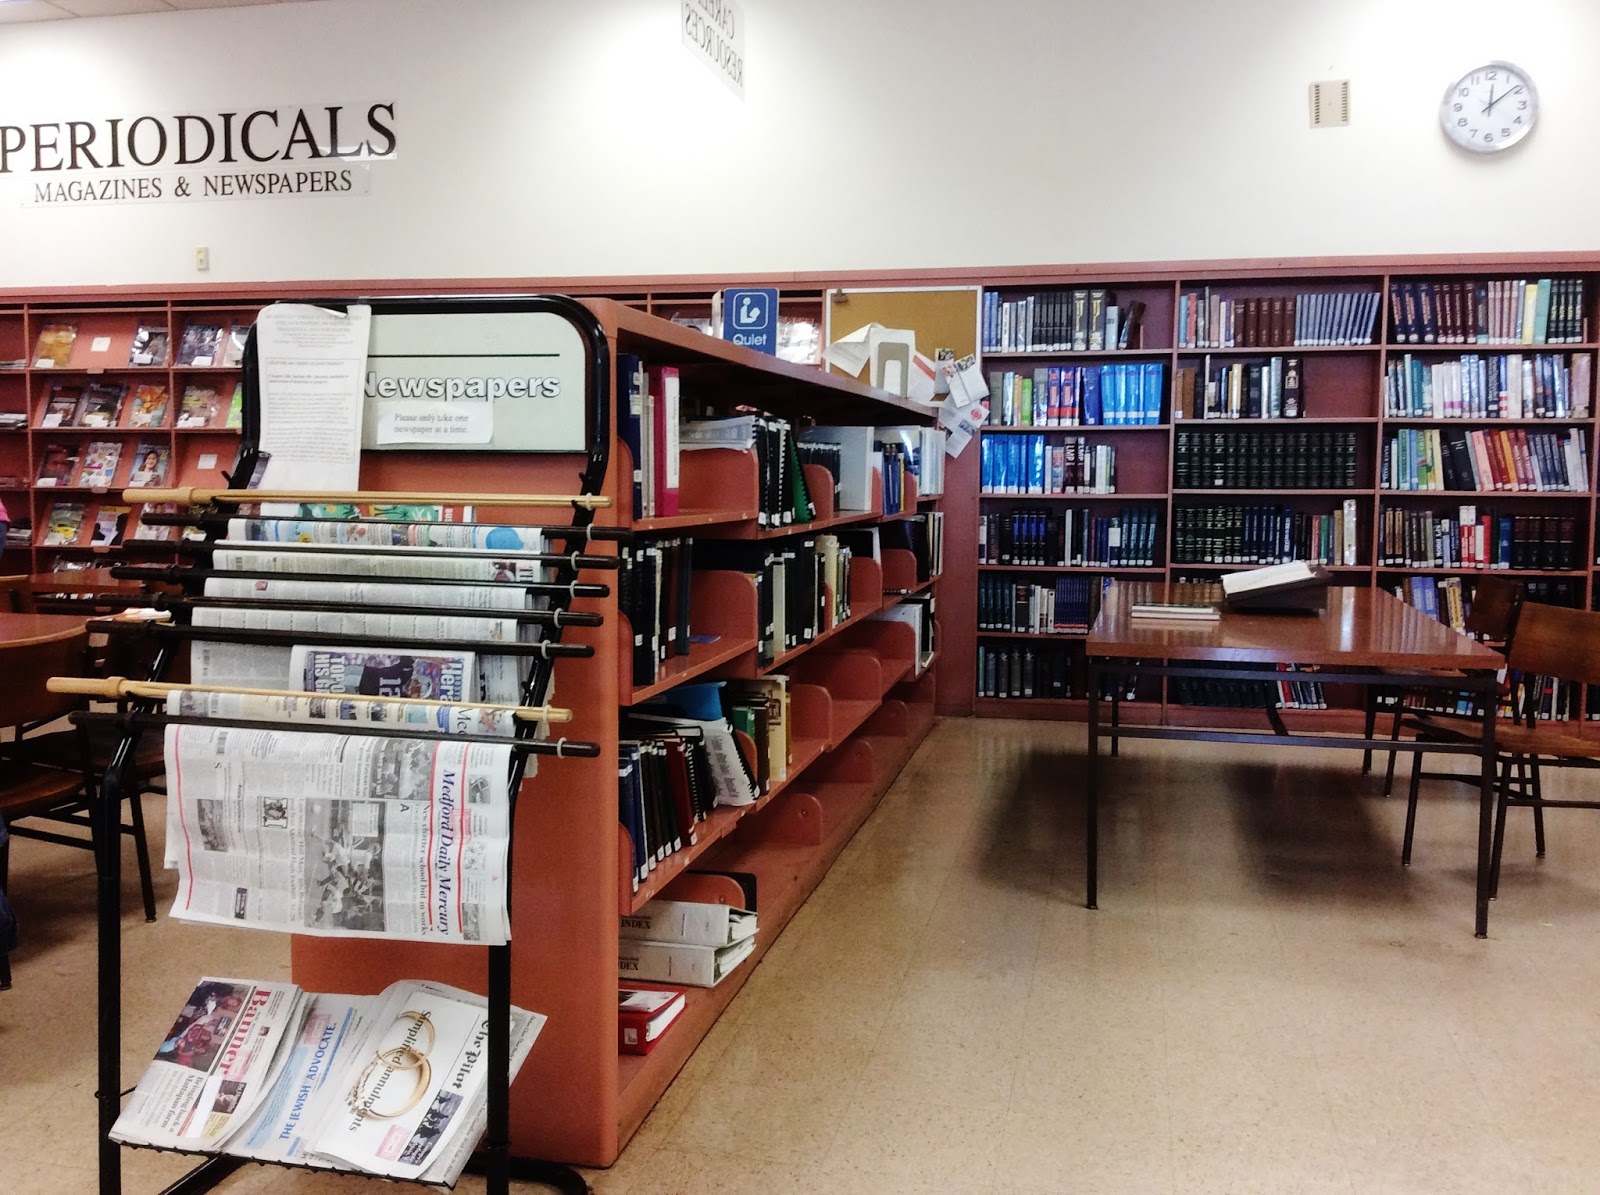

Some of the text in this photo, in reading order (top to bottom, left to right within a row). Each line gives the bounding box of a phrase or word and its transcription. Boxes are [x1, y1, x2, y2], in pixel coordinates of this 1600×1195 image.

[1471, 76, 1479, 85] 11
[1485, 71, 1497, 80] 12
[1458, 87, 1469, 97] 10
[1513, 85, 1523, 94] 2
[1453, 103, 1463, 112] 9
[1517, 101, 1527, 110] 3
[1457, 118, 1468, 127] 8
[1513, 116, 1522, 124] 4
[0, 102, 397, 173] PERIODICALS
[1469, 129, 1478, 138] 7
[1483, 133, 1493, 142] 6
[1501, 128, 1511, 137] 5
[35, 170, 352, 203] MAGAZINES & NEWSPAPERS
[733, 333, 767, 346] Quiet
[364, 371, 561, 402] Newspapers
[394, 413, 417, 422] Please
[419, 413, 435, 424] only
[437, 414, 453, 422] take
[394, 426, 433, 435] newspaper
[314, 654, 329, 677] HIS
[330, 655, 345, 681] TOP
[440, 662, 462, 702] Hera
[454, 675, 462, 700] BOSTO
[420, 824, 428, 853] charter
[436, 769, 456, 935] Medford Daily Mercury
[419, 856, 427, 882] school
[420, 884, 428, 898] bid
[420, 911, 429, 936] works
[621, 919, 651, 929] INDEX
[619, 961, 639, 971] DEX
[219, 989, 272, 1076] Banner
[347, 1009, 432, 1133] Simplified annulments
[452, 1048, 482, 1090] Pilot
[279, 1024, 338, 1140] THE JEWISH ADVOCATE
[180, 1076, 204, 1109] Bringing
[160, 1074, 195, 1130] Mattapan farm
[171, 1109, 189, 1127] back
